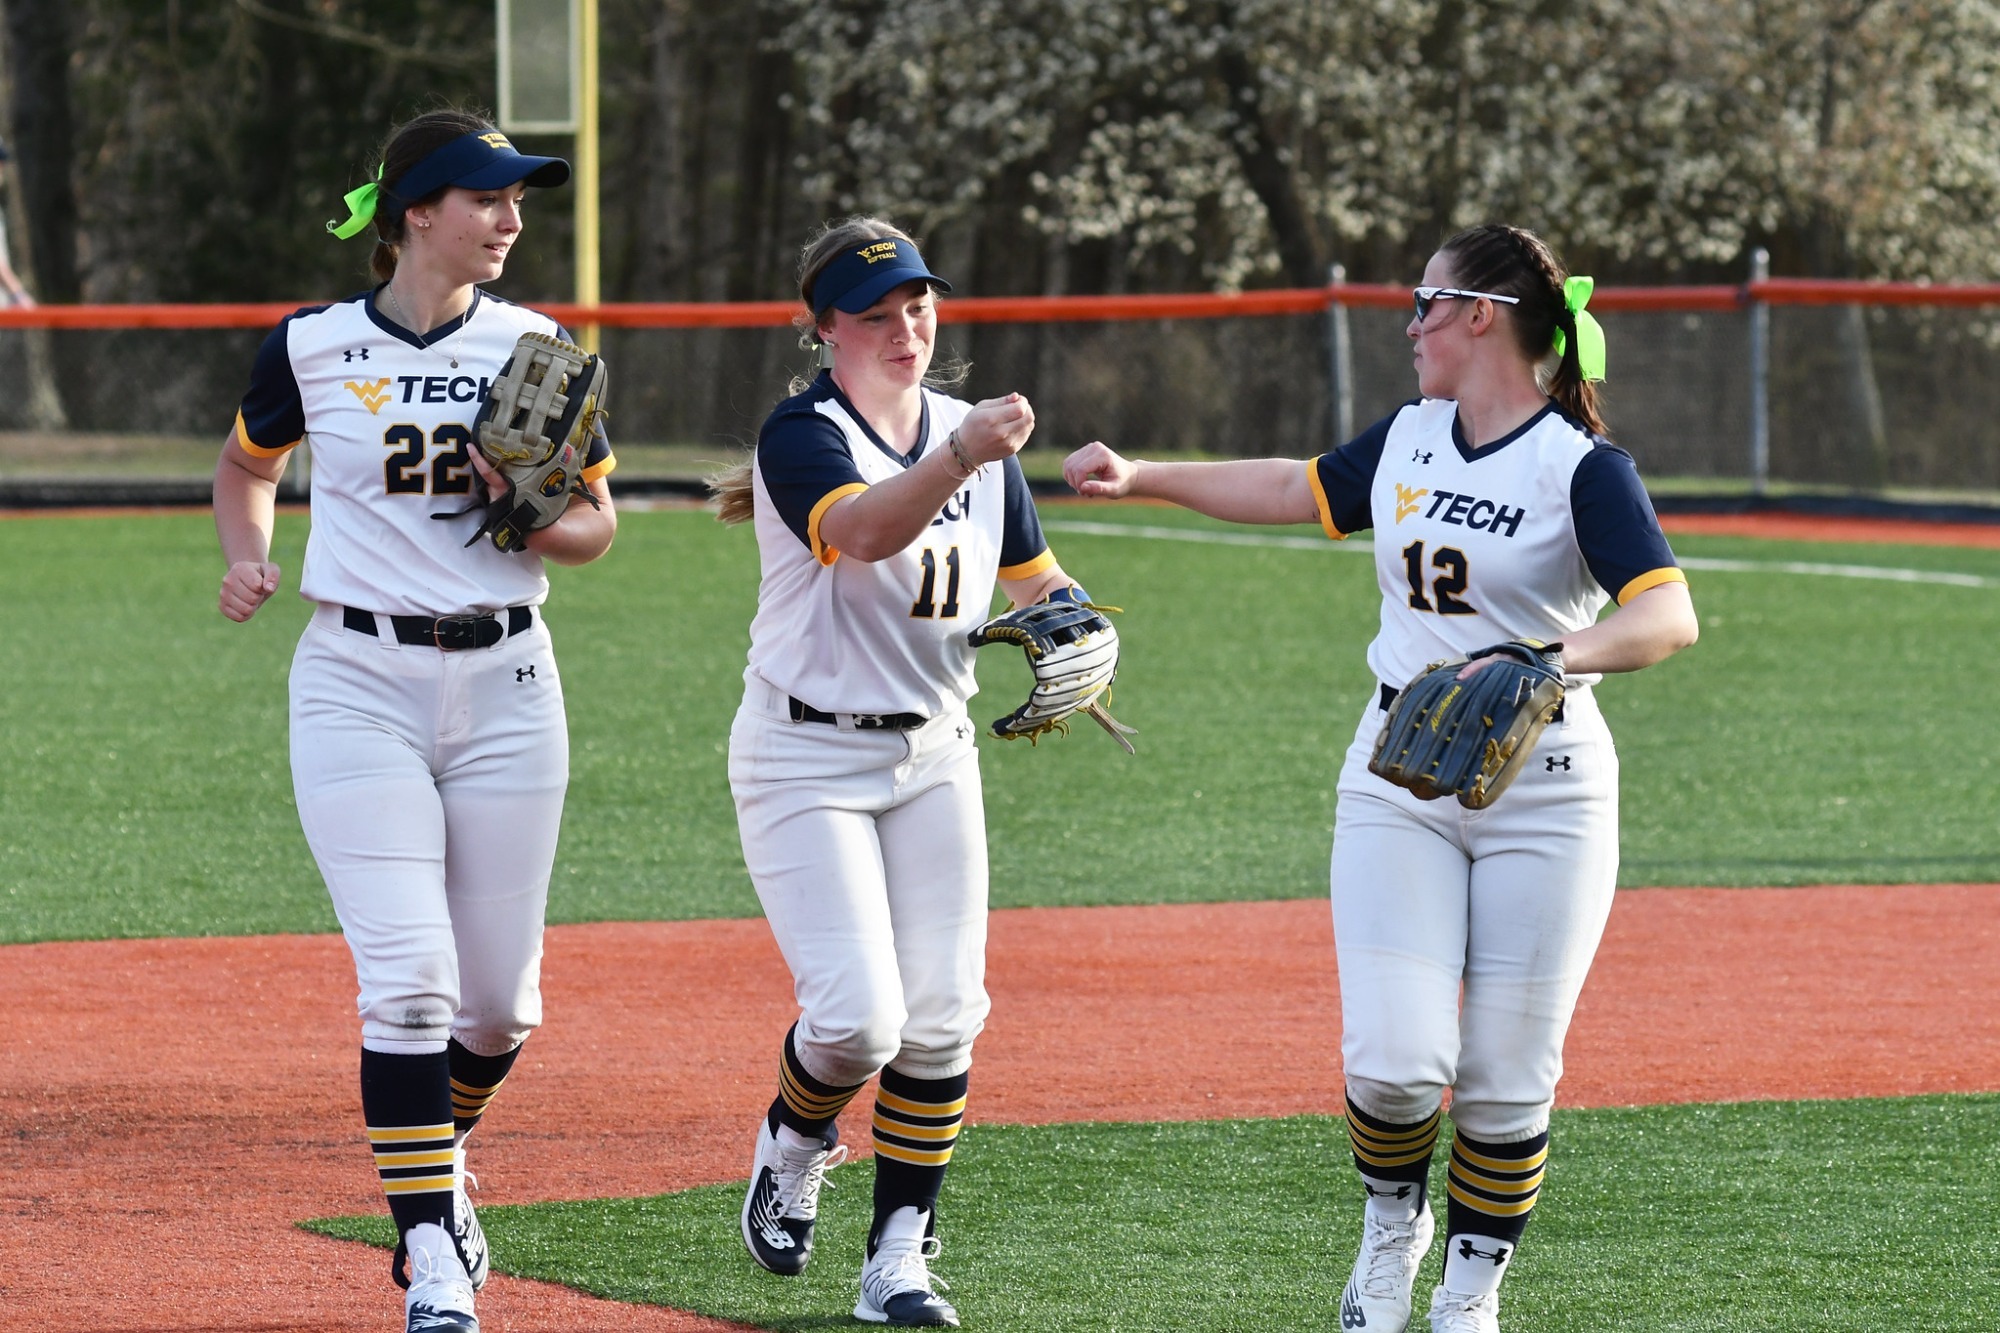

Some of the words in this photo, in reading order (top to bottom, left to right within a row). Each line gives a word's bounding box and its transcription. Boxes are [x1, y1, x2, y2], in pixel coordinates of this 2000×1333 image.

[869, 241, 897, 253] TECH
[382, 422, 472, 496] 22
[930, 489, 971, 526] CH
[1425, 489, 1526, 538] TECH
[909, 544, 961, 620] 11
[1401, 538, 1480, 616] 12
